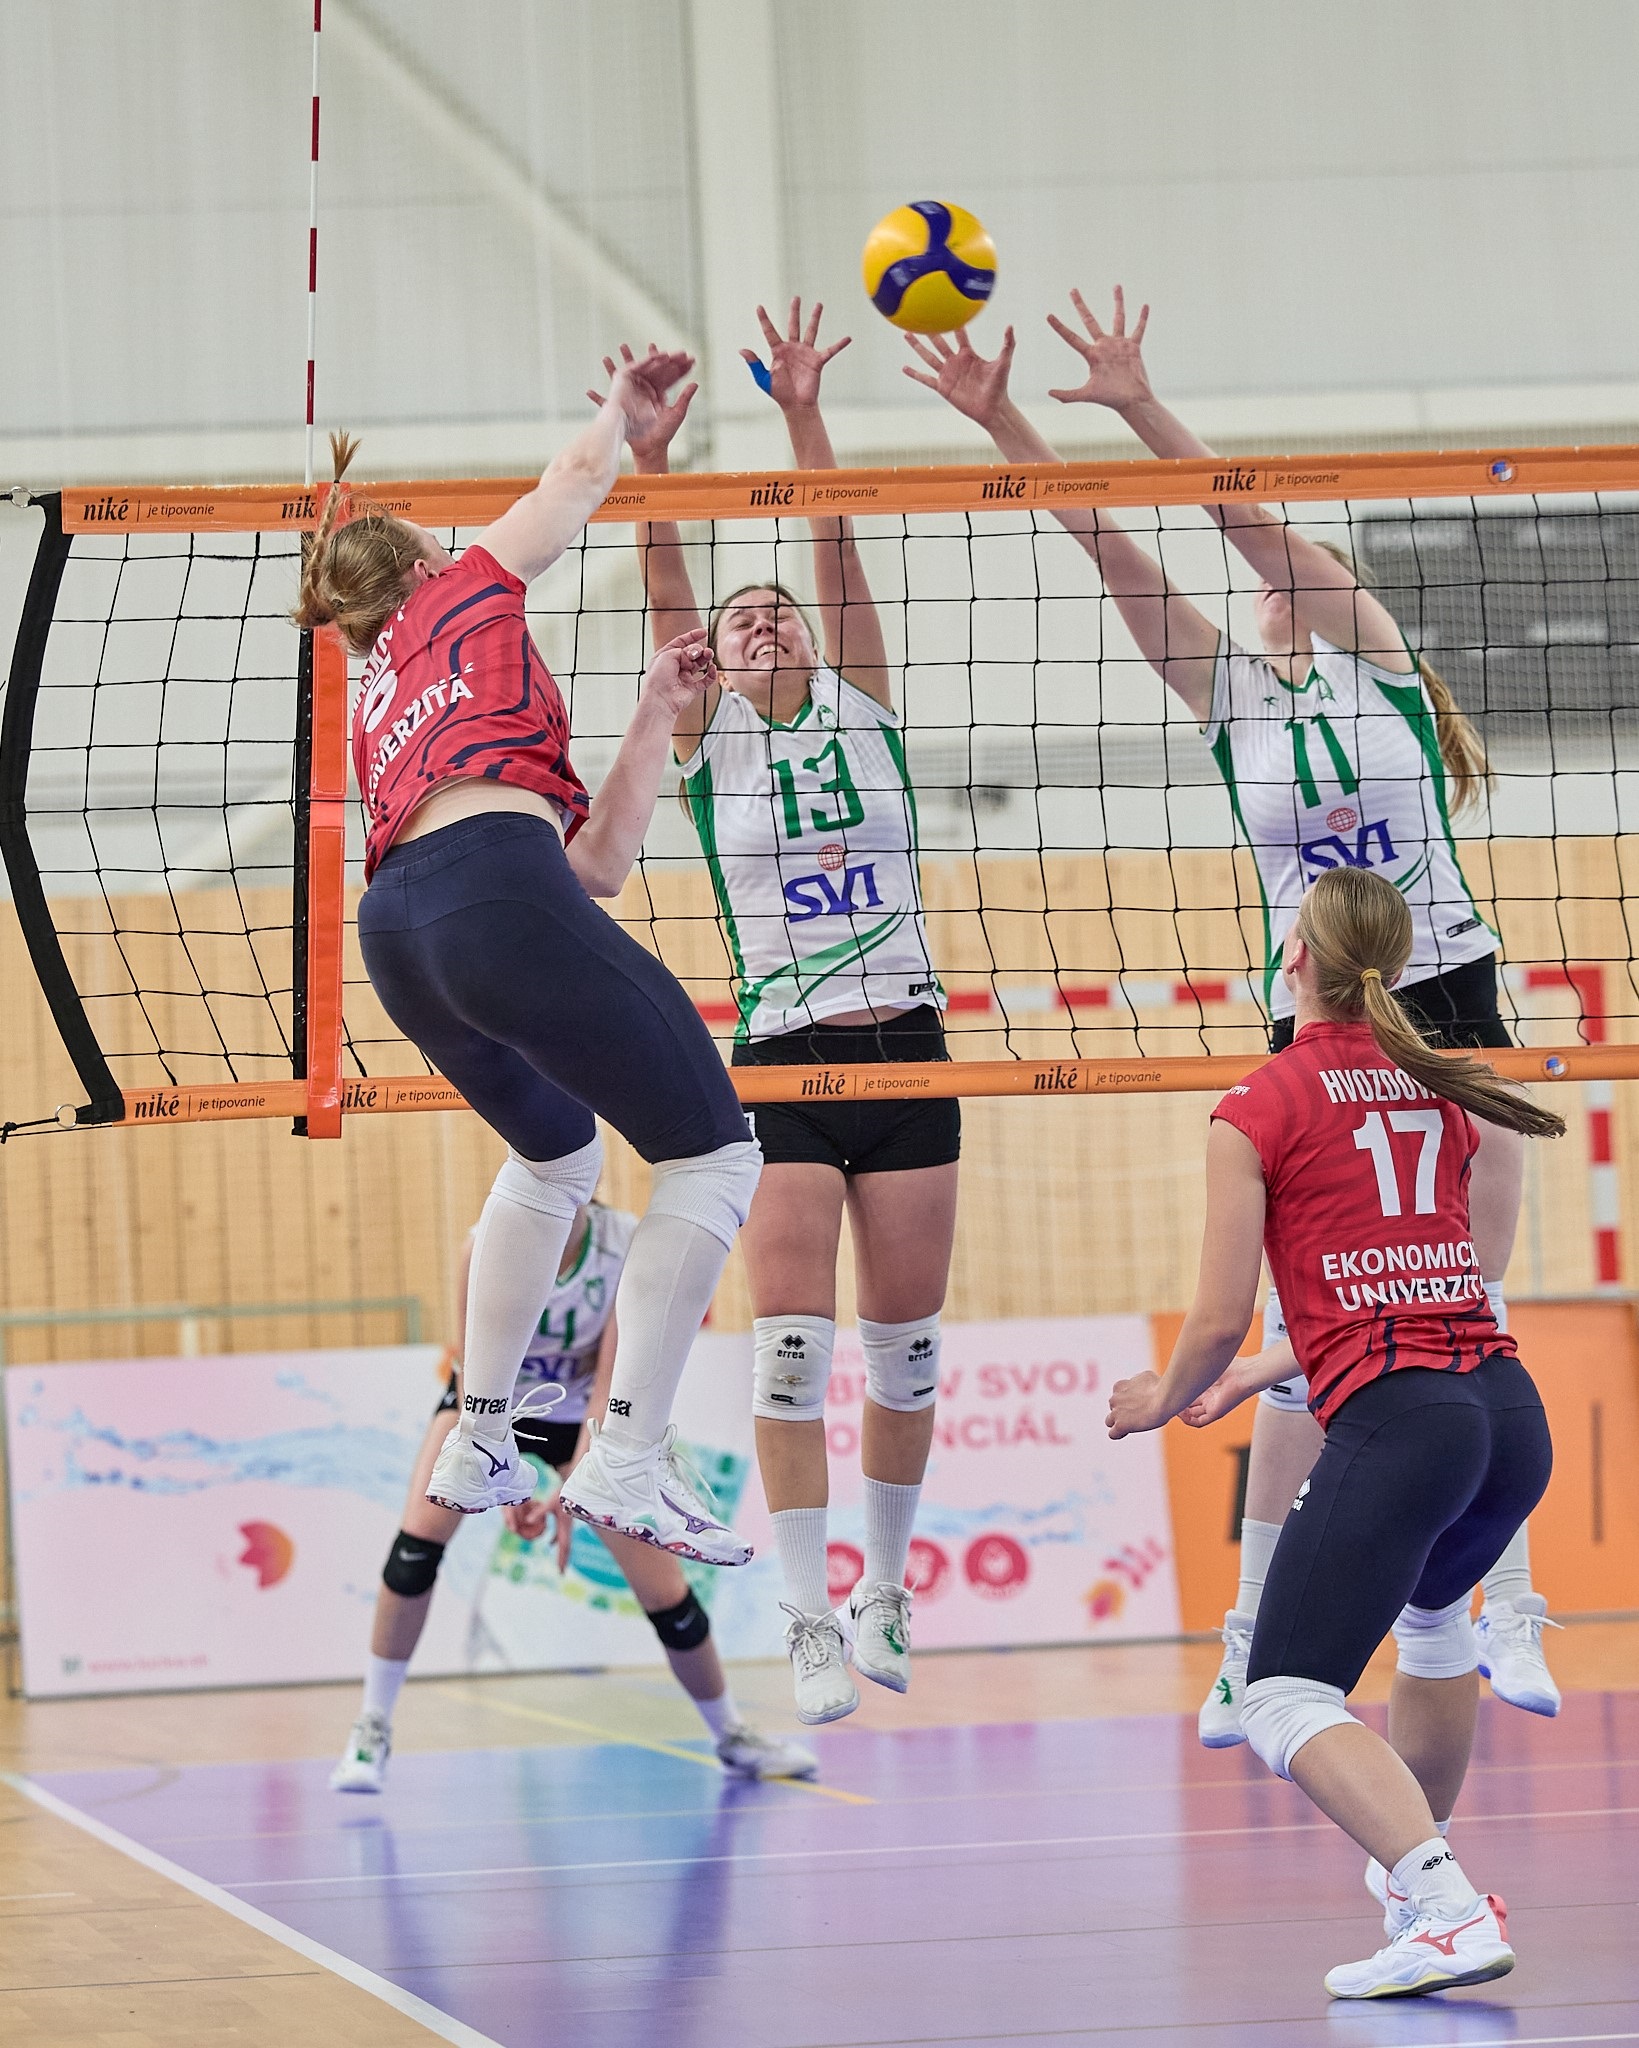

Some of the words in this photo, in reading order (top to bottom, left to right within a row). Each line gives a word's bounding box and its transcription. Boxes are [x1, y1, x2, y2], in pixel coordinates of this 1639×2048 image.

[982, 474, 1026, 499] niké
[1043, 480, 1055, 495] je
[1056, 479, 1109, 494] tipovanie
[1212, 467, 1256, 492] niké
[1273, 473, 1285, 488] je
[1286, 471, 1339, 487] tipovanie
[282, 495, 317, 519] nik
[750, 481, 794, 507] niké
[812, 487, 824, 502] je
[826, 485, 879, 501] tipovanie
[83, 496, 128, 521] niké
[146, 503, 158, 518] je
[160, 502, 215, 518] tipovanie
[1285, 712, 1359, 809] 11
[767, 738, 865, 840] 13
[801, 1070, 845, 1096] niké
[863, 1077, 875, 1091] je
[876, 1075, 930, 1090] tipovanie
[1033, 1065, 1078, 1091] niké
[1095, 1072, 1106, 1086] je
[1108, 1070, 1161, 1085] tipovanie
[134, 1093, 180, 1118] niké
[198, 1098, 210, 1113] je
[211, 1095, 265, 1111] tipovanie
[395, 1090, 406, 1104] je
[409, 1088, 462, 1103] tipovanie
[1352, 1108, 1444, 1217] 17
[978, 1359, 1099, 1400] SVOJ
